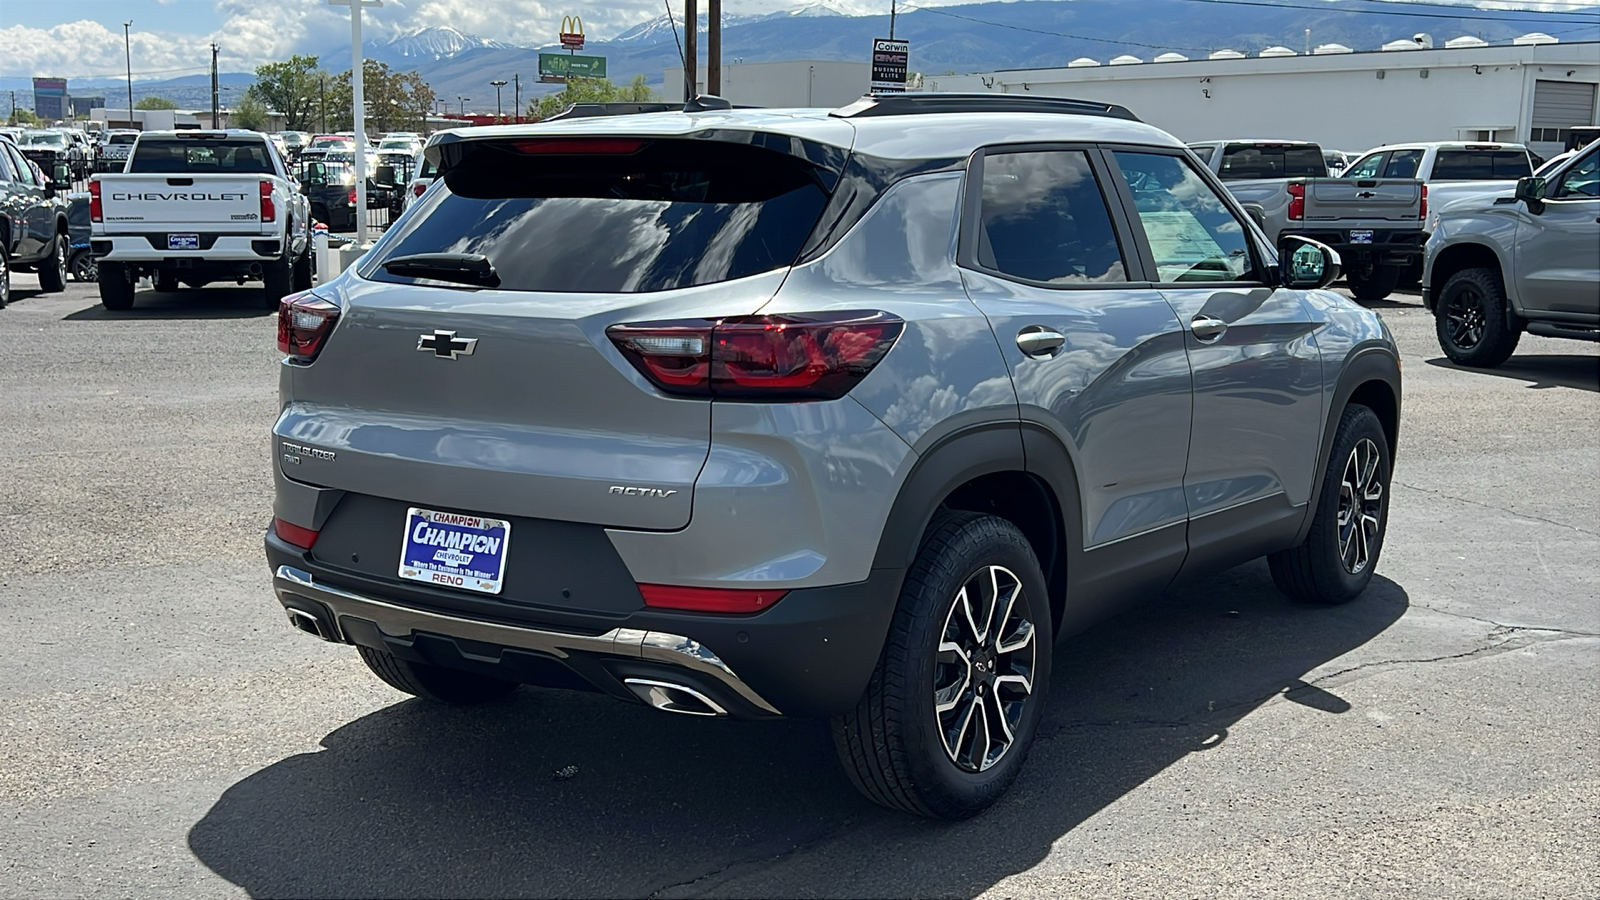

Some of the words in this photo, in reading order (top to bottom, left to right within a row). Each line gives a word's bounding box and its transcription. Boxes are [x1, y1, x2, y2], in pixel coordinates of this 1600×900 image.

[878, 42, 908, 51] Corwin
[875, 54, 906, 63] GMC
[112, 193, 249, 201] CHEVROLET
[282, 441, 336, 462] TRAILBLAZER
[284, 454, 301, 465] AWD
[608, 485, 678, 498] ACTIV
[433, 512, 481, 528] CHAMPION
[412, 522, 500, 555] CHAMPION
[436, 551, 471, 563] CHEVROLET
[428, 562, 438, 570] The
[437, 564, 460, 575] Customer
[465, 568, 474, 576] The
[432, 573, 464, 586] RENO
